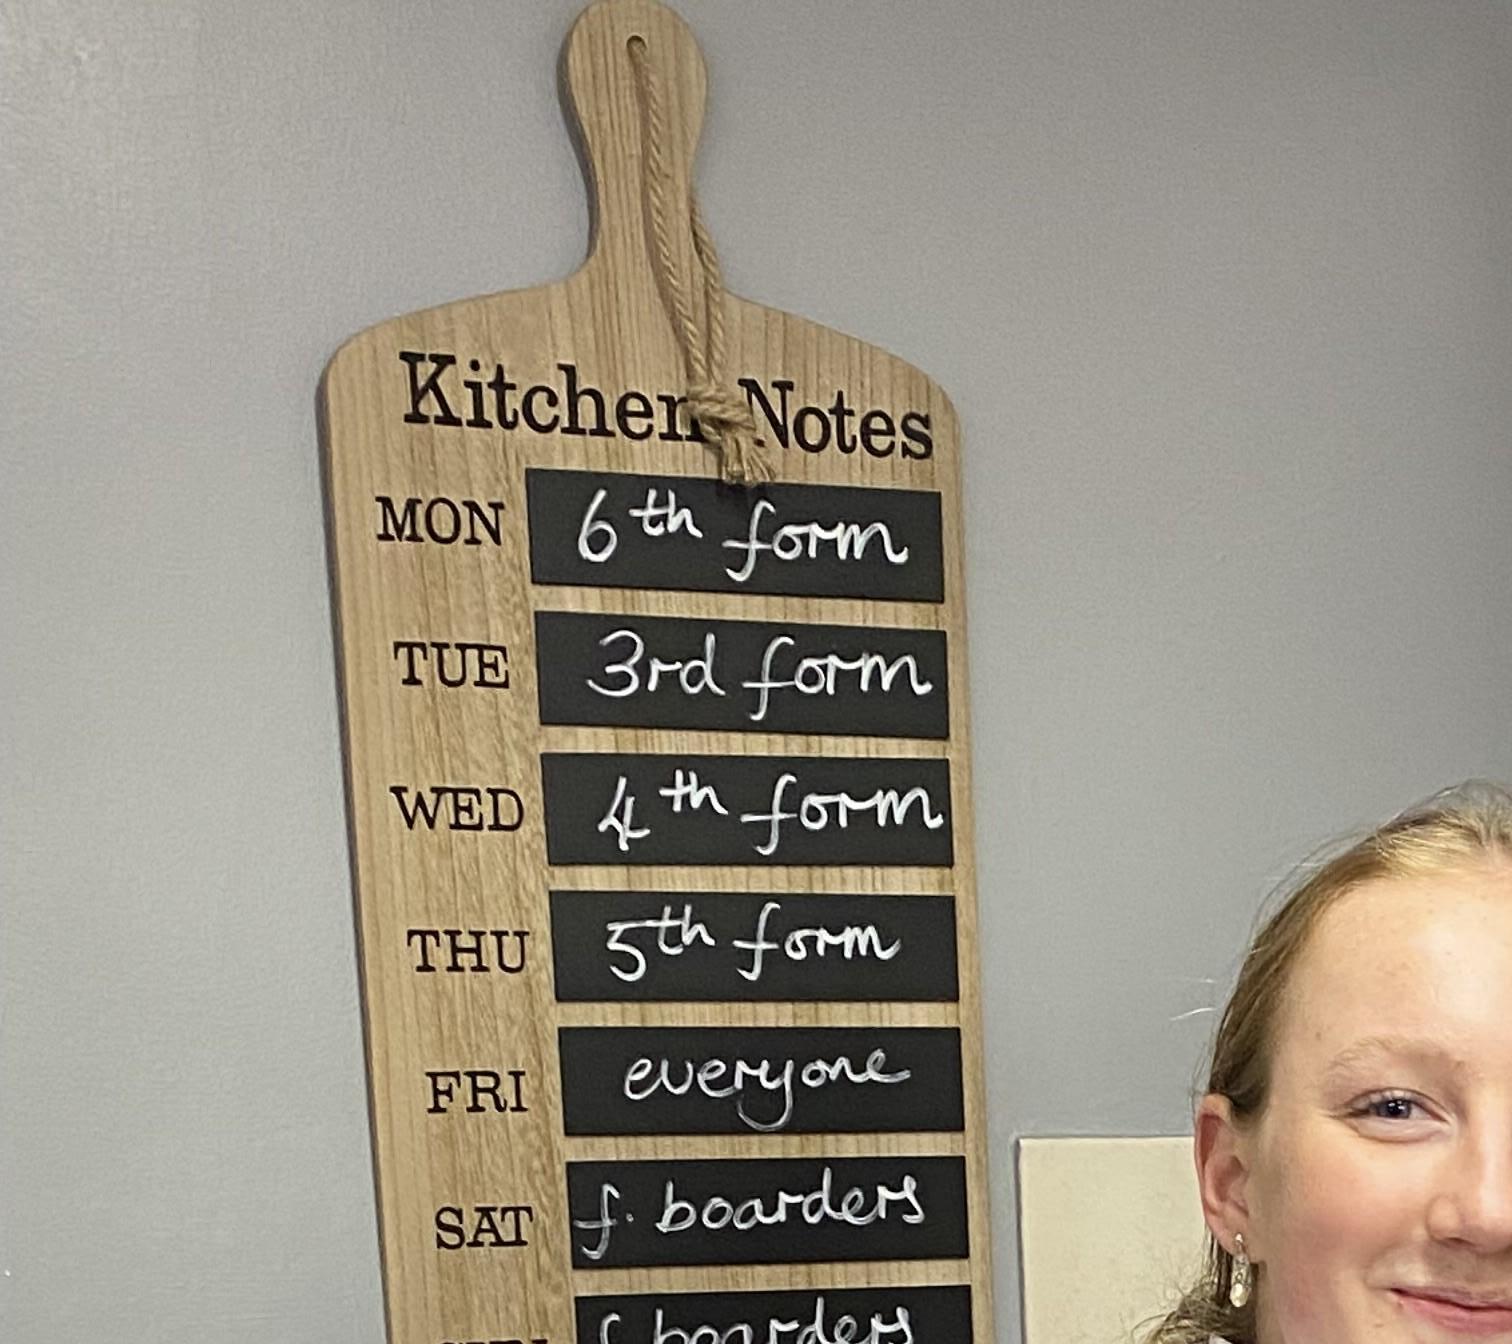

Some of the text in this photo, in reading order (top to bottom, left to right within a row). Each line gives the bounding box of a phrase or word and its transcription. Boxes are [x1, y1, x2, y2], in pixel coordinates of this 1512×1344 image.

[399, 352, 933, 463] Kitchen Notes
[376, 497, 504, 545] MON
[578, 489, 908, 582] 6th form
[394, 642, 509, 688] TUE
[587, 630, 932, 721] 3rd form
[390, 786, 523, 831] WED
[598, 769, 944, 855] 4th form
[407, 930, 529, 973] THU
[607, 902, 900, 981] 5th form
[426, 1071, 528, 1113] FRI
[624, 1049, 911, 1132] everyone
[435, 1207, 533, 1249] SAT
[656, 1167, 924, 1233] boarders
